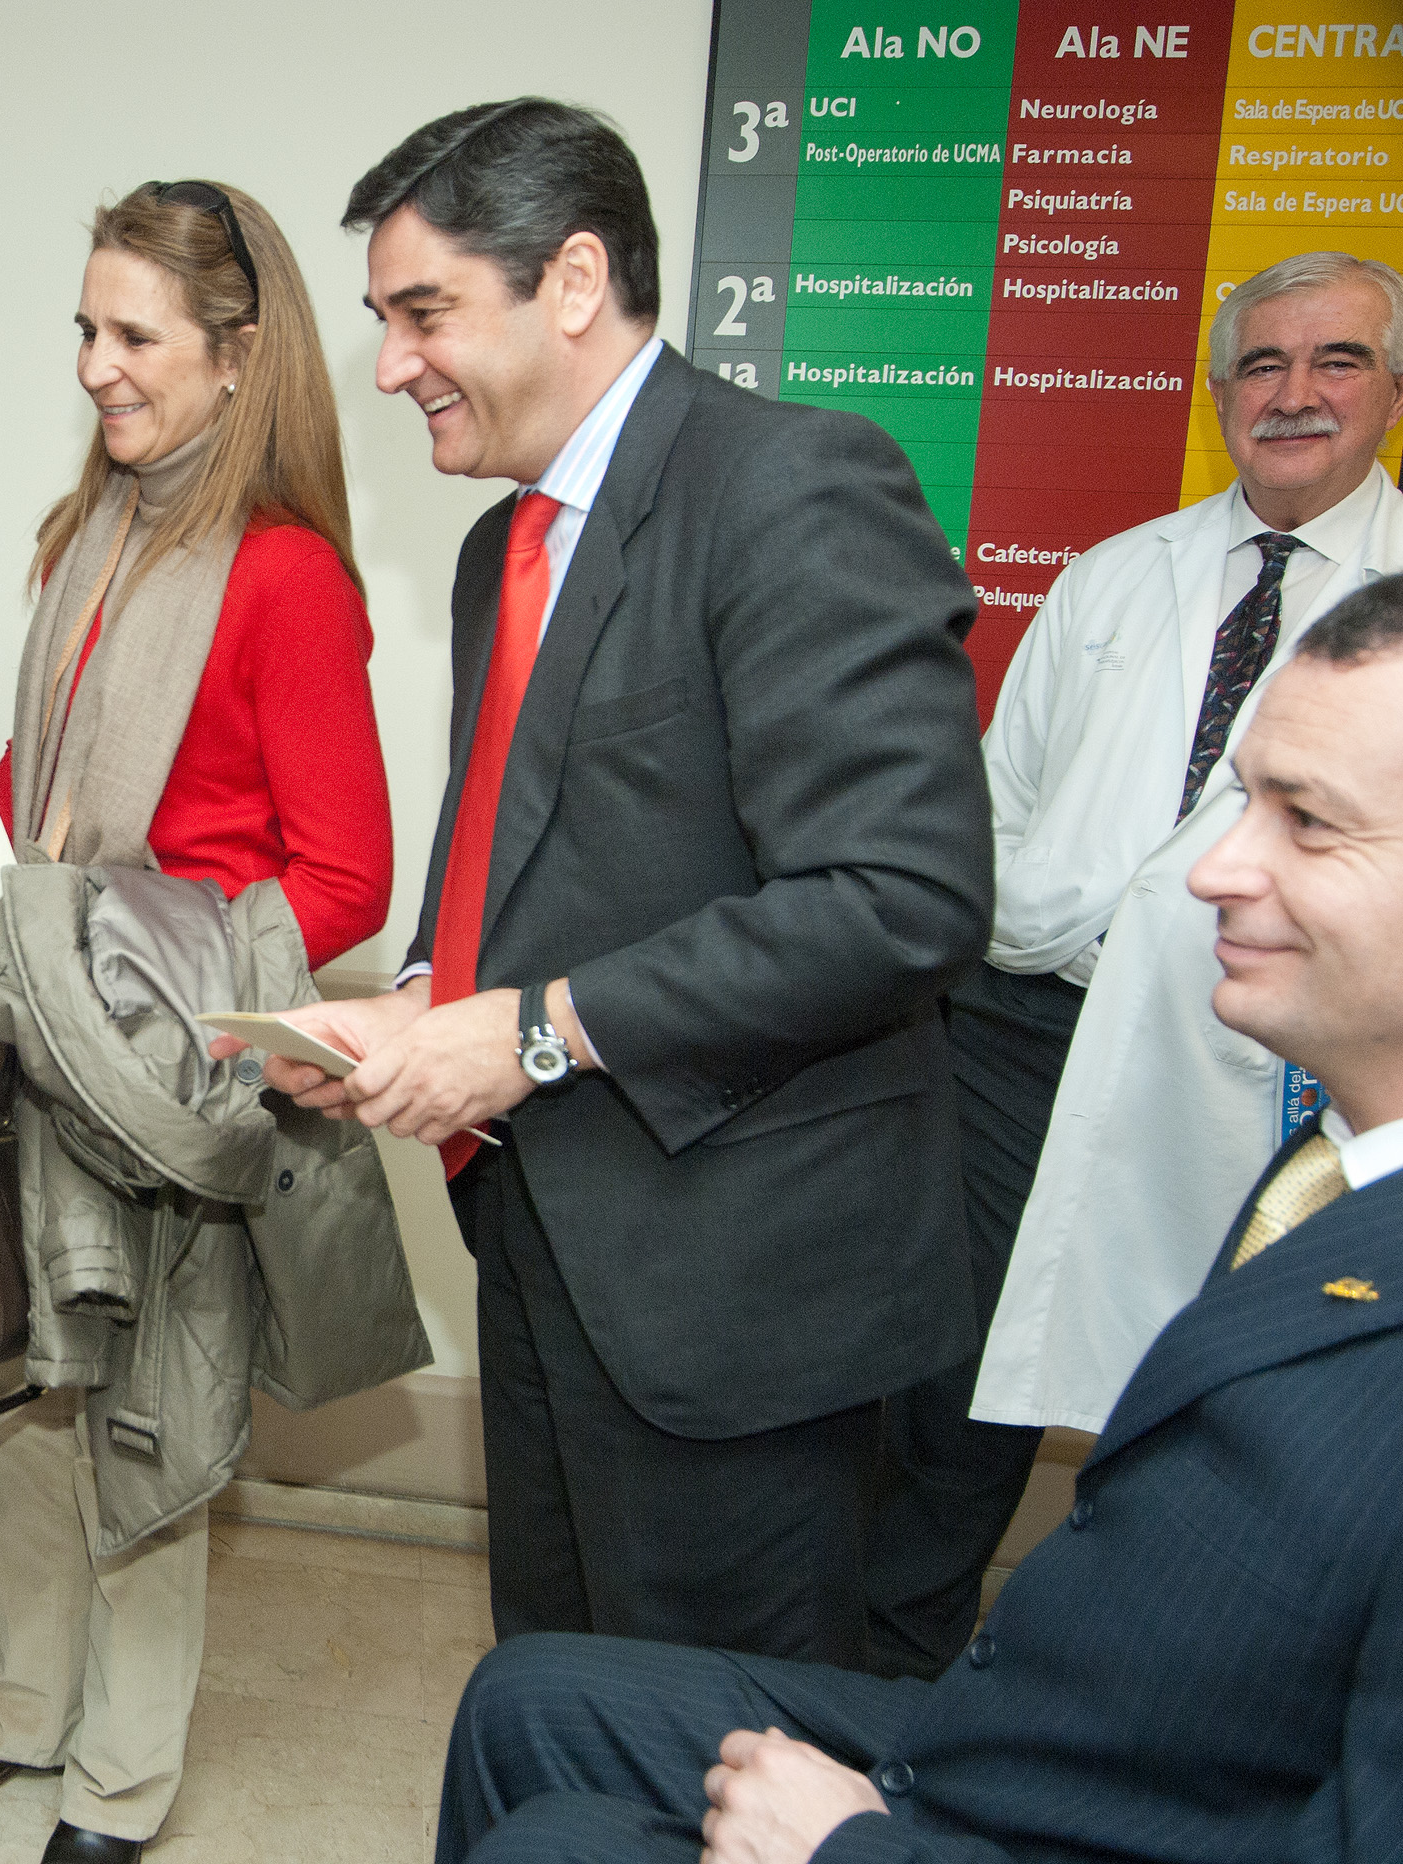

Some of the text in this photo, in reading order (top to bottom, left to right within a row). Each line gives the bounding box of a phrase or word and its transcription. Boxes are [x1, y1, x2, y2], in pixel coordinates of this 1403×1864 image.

[840, 25, 981, 58] Ala NO
[1054, 25, 1190, 58] Ala NE
[809, 97, 856, 117] UCI
[1019, 98, 1158, 125] Neurología
[1234, 98, 1269, 120] Sala
[1271, 99, 1293, 120] de
[1294, 98, 1351, 125] Espera
[1354, 99, 1375, 120] de
[806, 142, 1001, 167] Post-Operatorio de UCMA
[1012, 143, 1133, 165] Farmacia
[1229, 145, 1389, 171] Respiratorio
[1007, 189, 1133, 215] Psiquiatría
[1224, 190, 1266, 212] Sala
[1273, 191, 1297, 212] de
[1303, 191, 1372, 218] Espera
[1003, 233, 1120, 260] Psicología
[795, 273, 974, 299] Hospitalización
[1003, 278, 1178, 304] Hospitalización
[787, 362, 975, 388] Hospitalización
[994, 366, 1183, 393] Hospitalización
[977, 543, 1081, 566] Cafetería
[973, 585, 1049, 612] Peluque
[1287, 1097, 1300, 1123] allá
